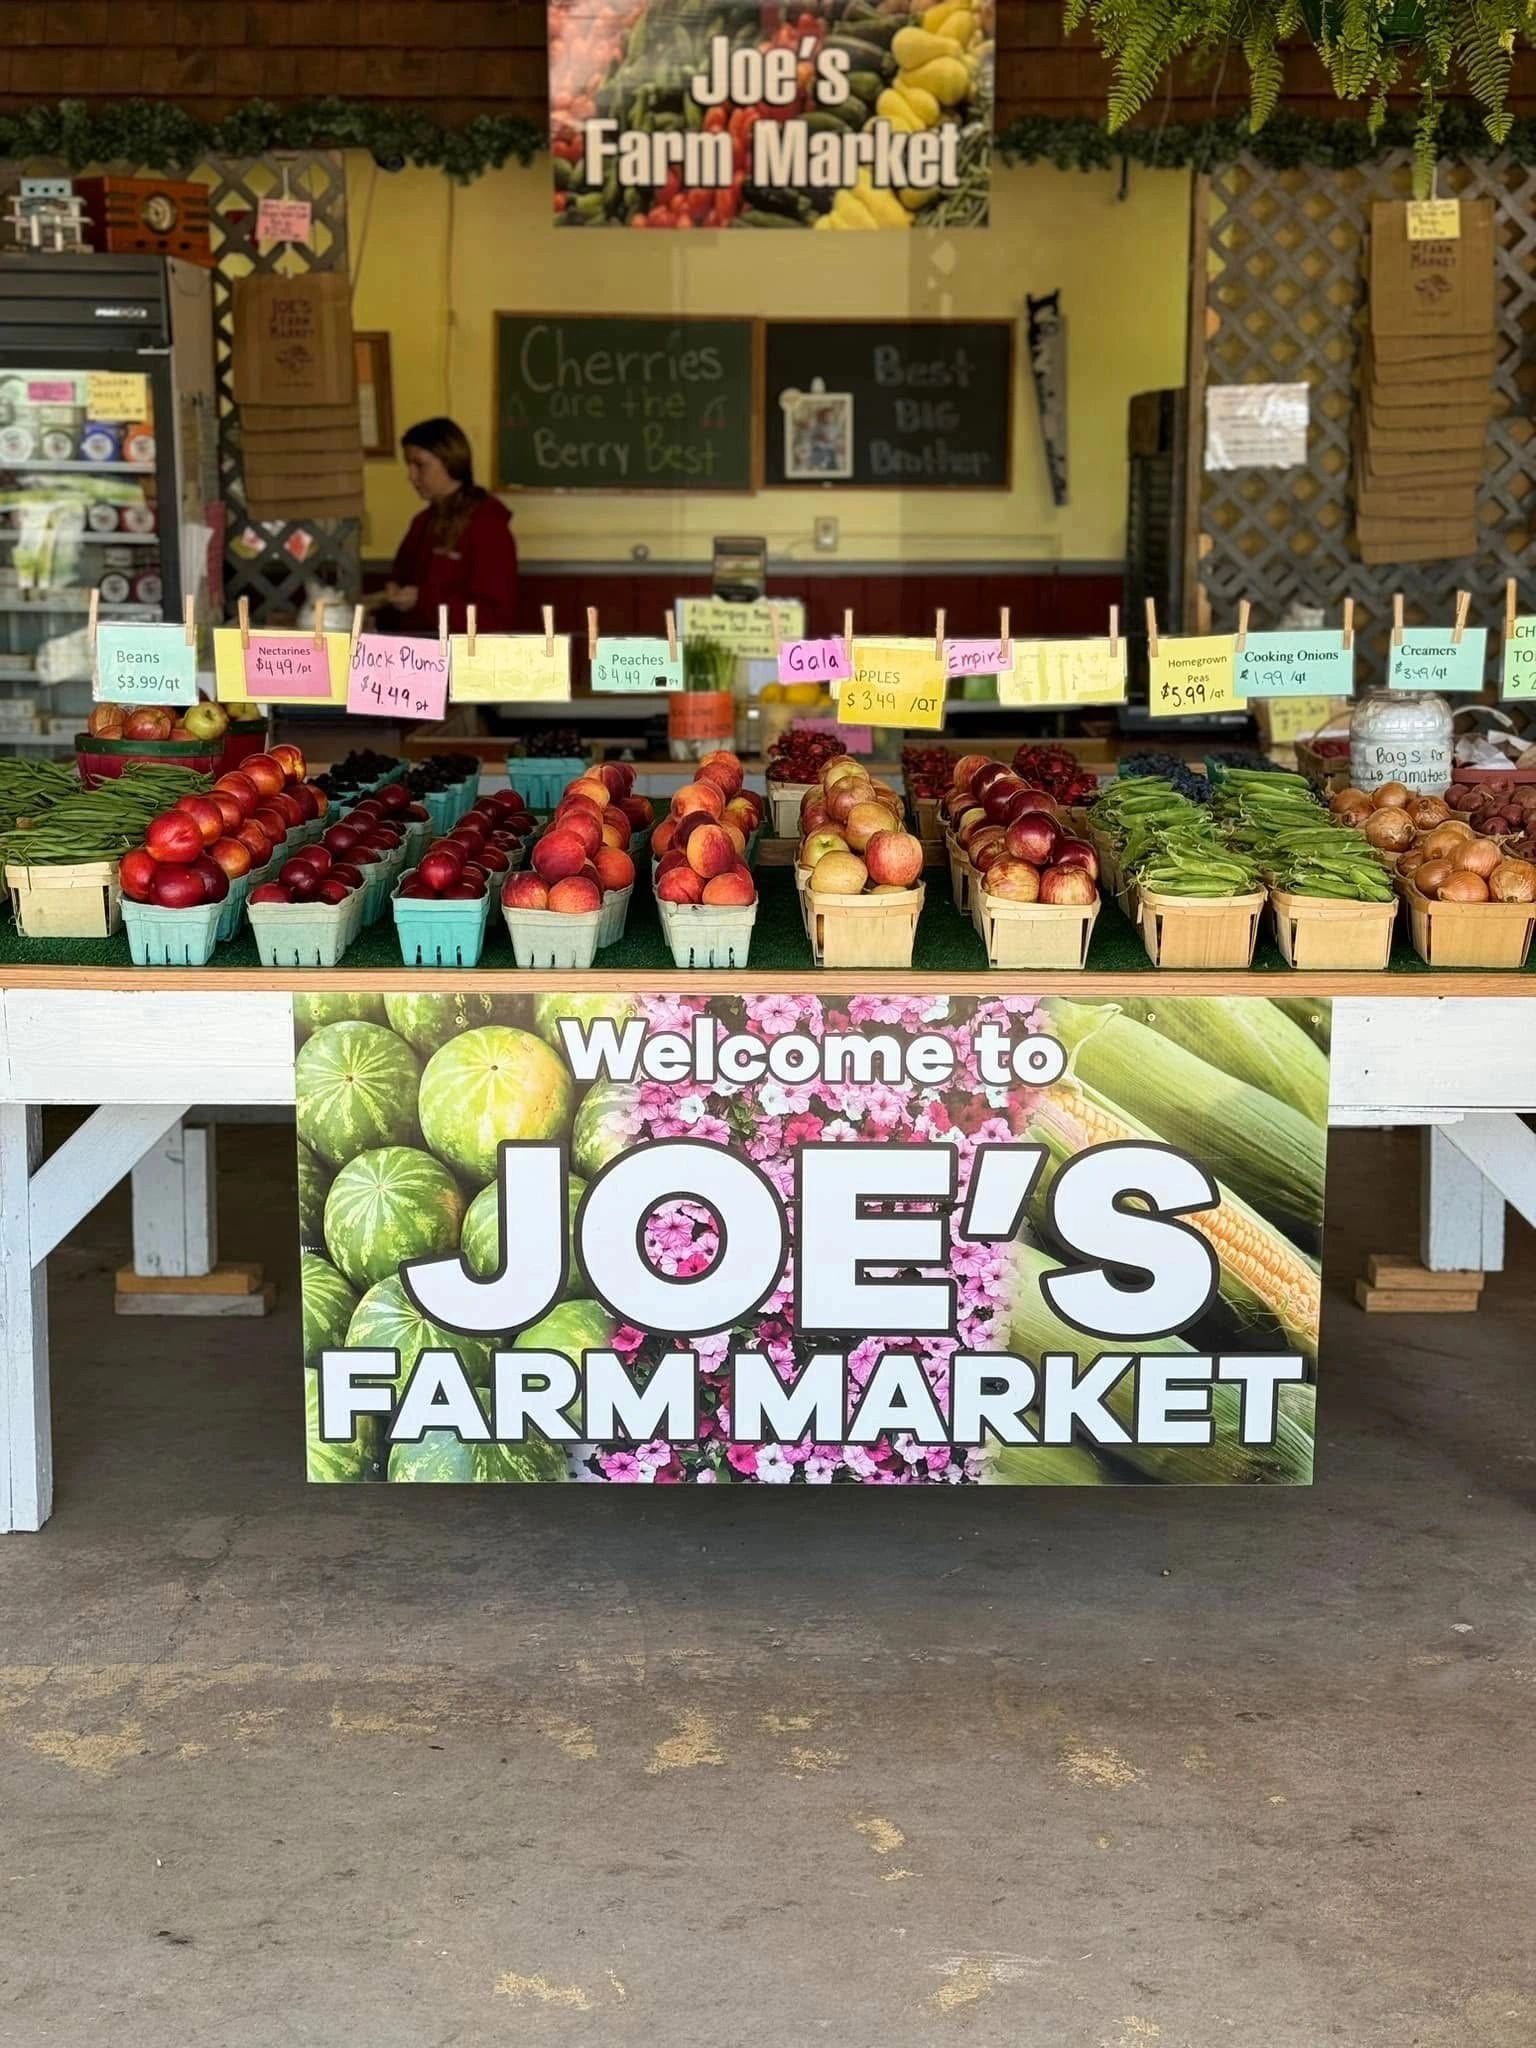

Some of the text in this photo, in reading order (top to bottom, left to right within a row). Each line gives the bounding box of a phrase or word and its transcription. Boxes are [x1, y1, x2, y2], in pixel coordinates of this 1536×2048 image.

[692, 34, 851, 106] Joe's
[584, 118, 960, 188] Farm Market
[520, 325, 724, 393] Cherries
[873, 344, 976, 389] Best
[549, 386, 686, 420] are the
[533, 422, 720, 476] Berry Best
[117, 650, 160, 664] Beans
[258, 646, 311, 656] Nectarines
[352, 641, 446, 672] Black Plums
[612, 654, 664, 666] Peaches
[789, 645, 839, 671] Gala
[948, 645, 1007, 670] Empire
[1168, 656, 1228, 668] Homegrown
[1244, 649, 1339, 664] Cooking Onions
[1400, 644, 1457, 656] Creamers
[1513, 649, 1536, 663] TO
[117, 674, 181, 691] $3.99/qt
[1187, 674, 1210, 684] Peas
[361, 674, 429, 712] $4.49 pt
[909, 697, 938, 713] /QT
[1160, 682, 1206, 708] $5.99
[1376, 746, 1445, 768] Bags for
[557, 1015, 1068, 1086] Welcome to
[401, 1138, 1222, 1338] JOE'S
[318, 1347, 1307, 1447] FARM MARKET
